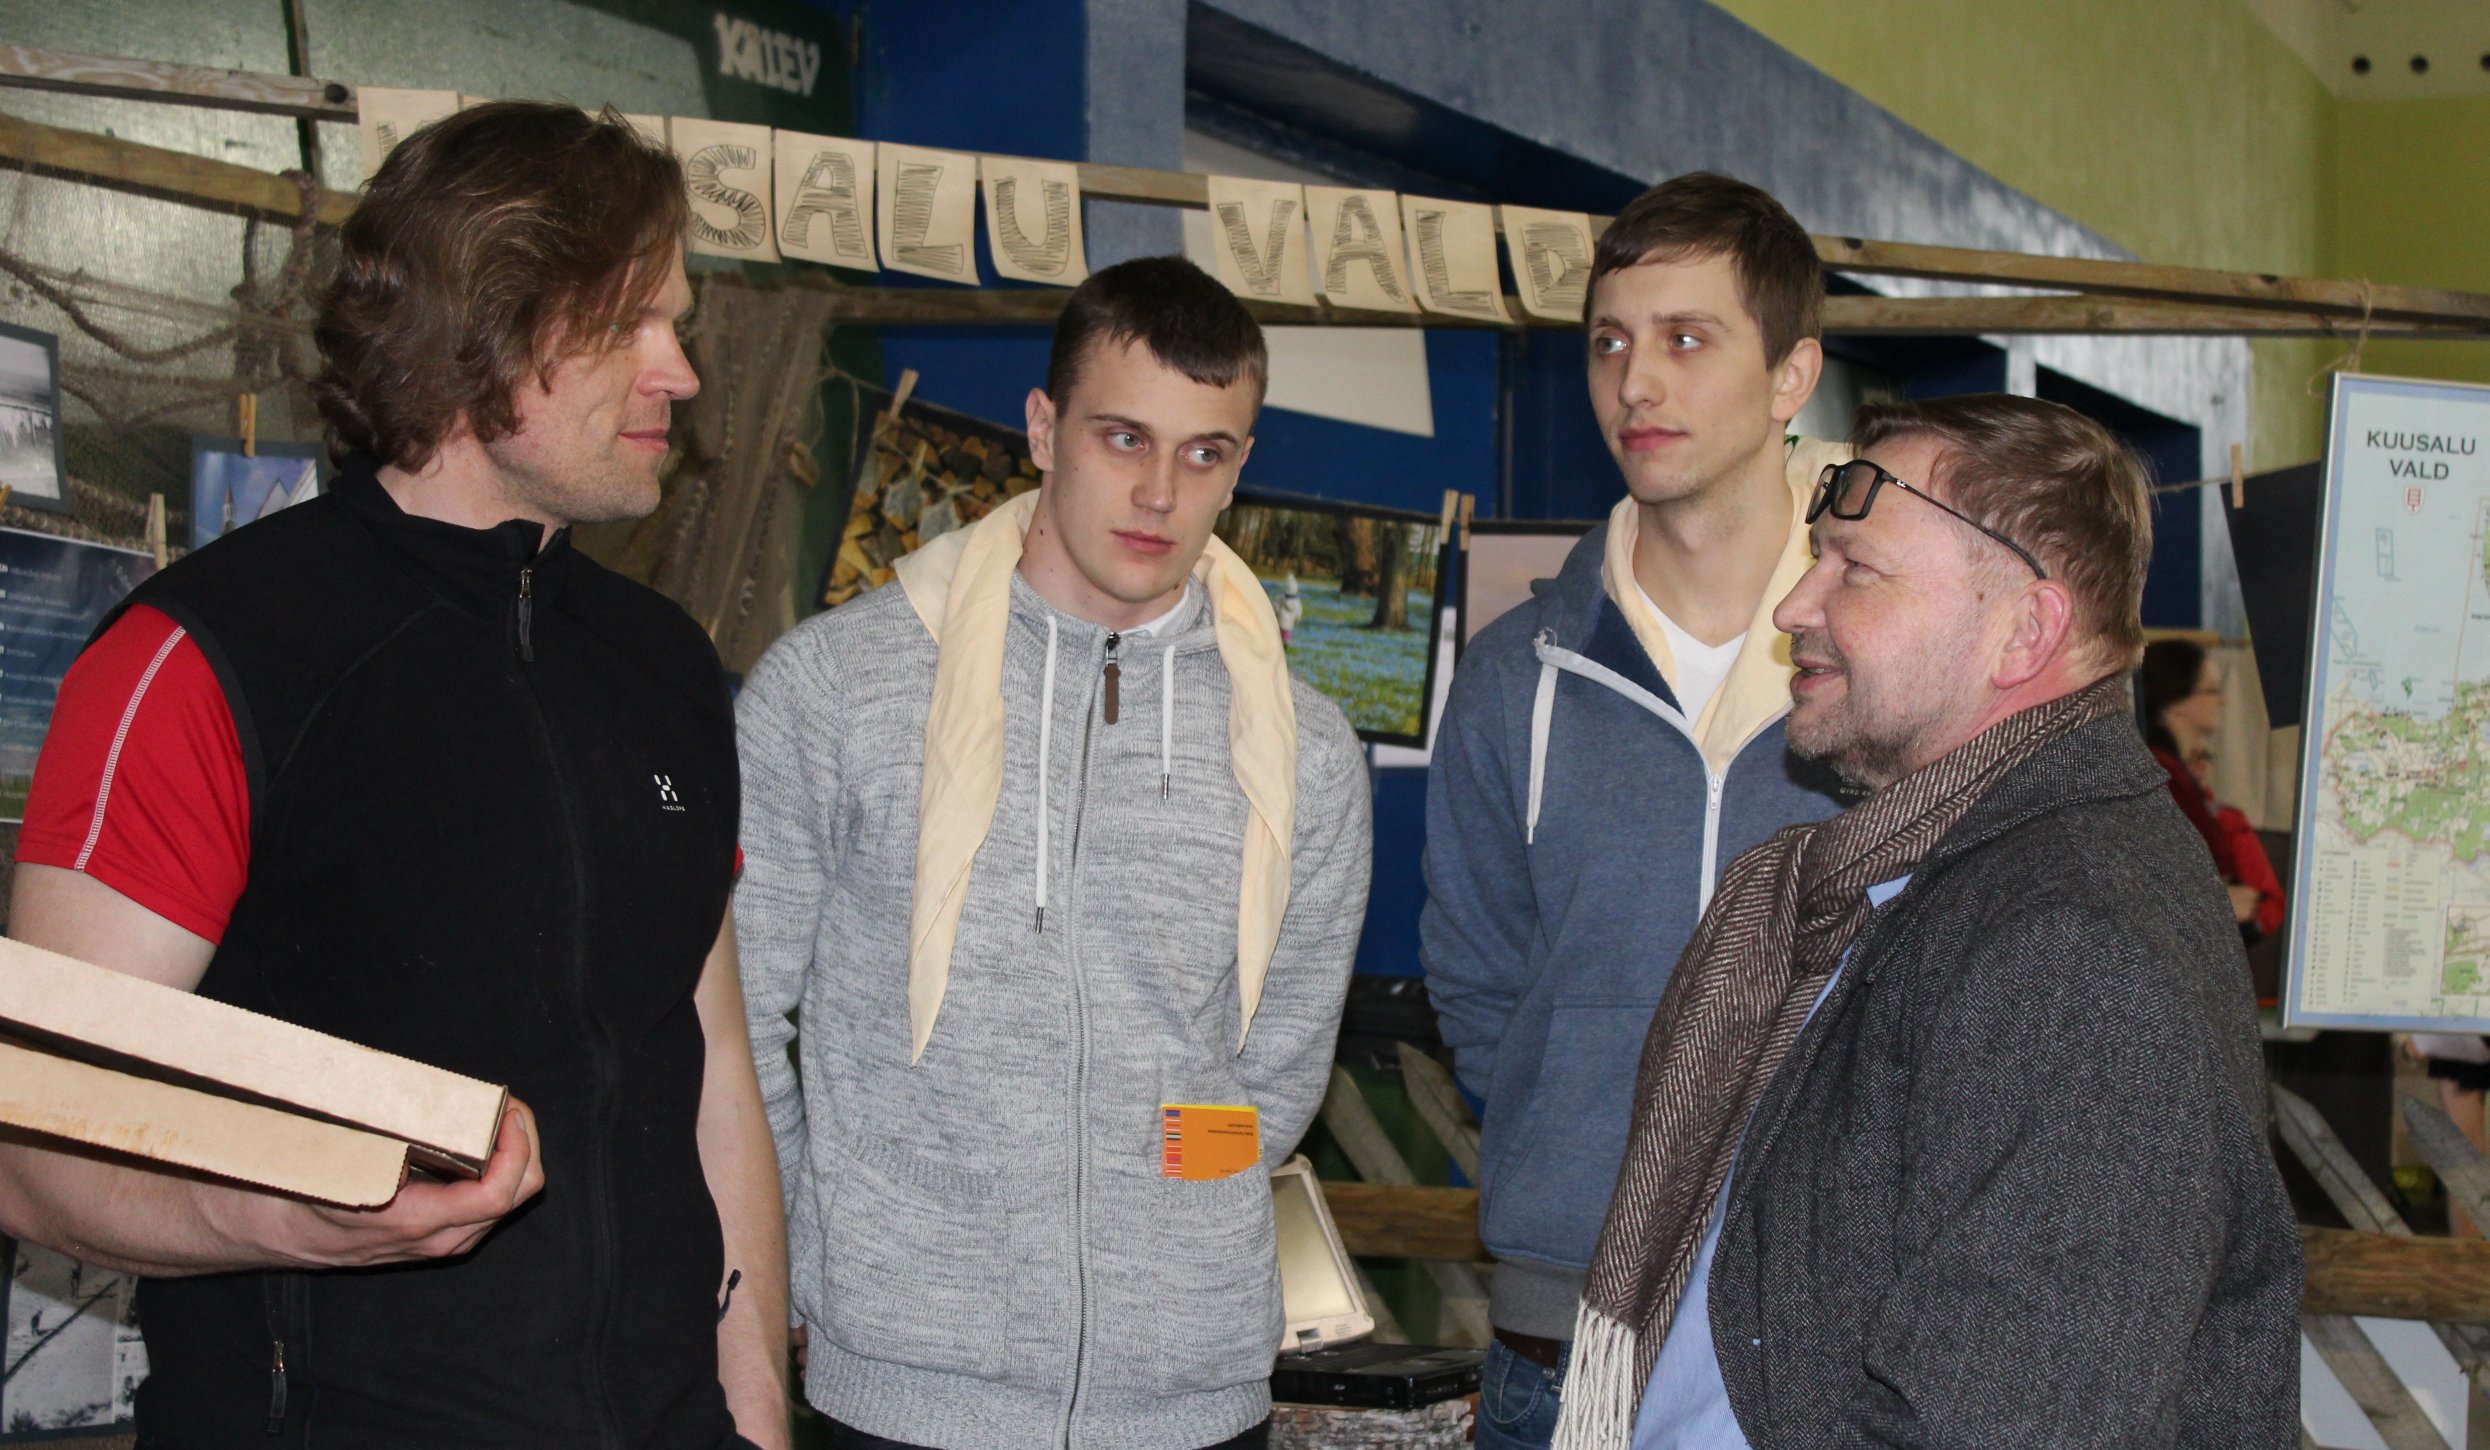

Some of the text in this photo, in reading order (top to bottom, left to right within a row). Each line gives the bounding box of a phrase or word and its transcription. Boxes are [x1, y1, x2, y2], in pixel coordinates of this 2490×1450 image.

[1207, 195, 1592, 314] VALD
[2367, 430, 2476, 455] KUUSALU
[2389, 459, 2450, 480] VALD
